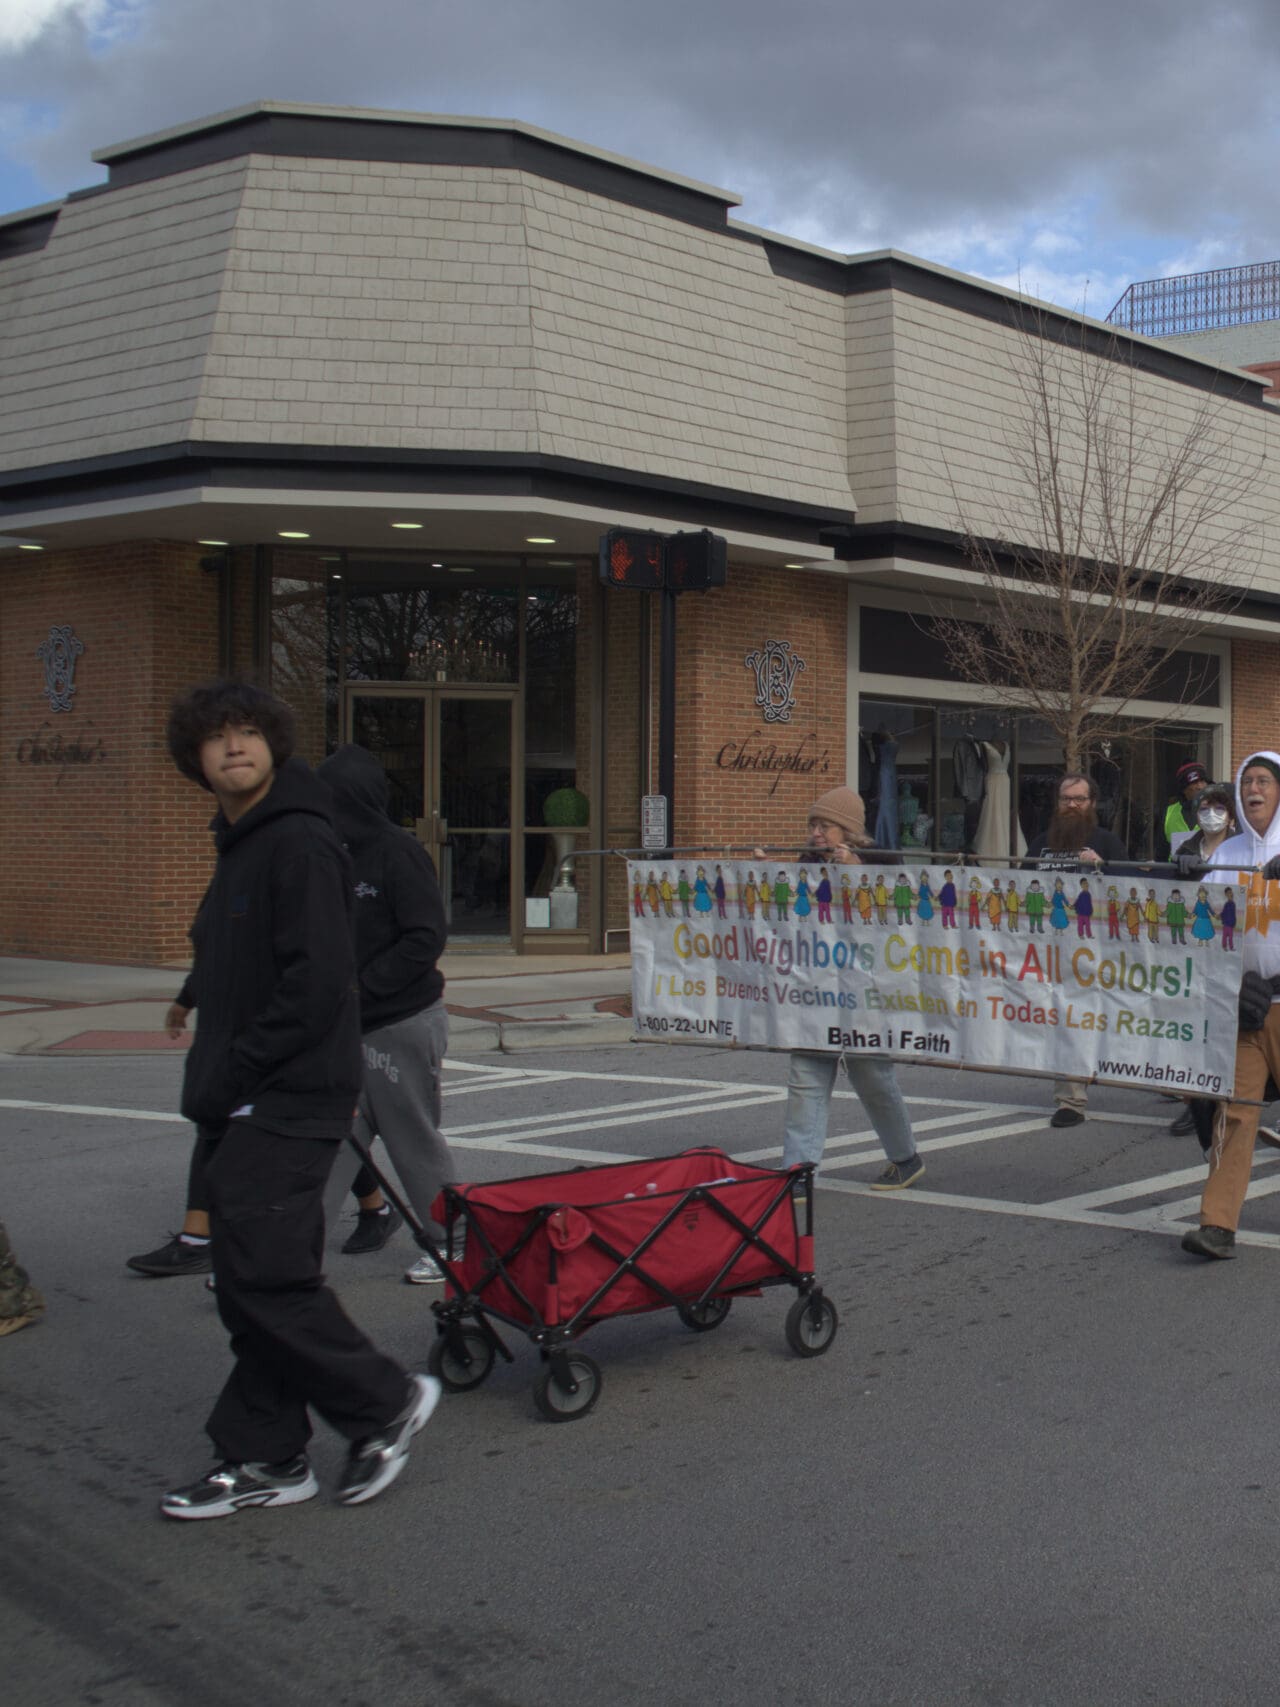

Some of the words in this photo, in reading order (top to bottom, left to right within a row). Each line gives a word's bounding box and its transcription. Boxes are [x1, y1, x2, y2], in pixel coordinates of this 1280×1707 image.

[716, 730, 830, 794] Christopher's
[674, 923, 739, 962] Good
[744, 926, 875, 976] Neighbors
[884, 933, 970, 977] Come
[979, 939, 1008, 980] in
[1018, 943, 1062, 985] All
[1071, 947, 1193, 998] Colors!
[669, 975, 706, 997] Los
[716, 976, 769, 1003] Buenos
[773, 982, 857, 1010] Vecinos
[864, 988, 949, 1016] Existen
[957, 999, 978, 1018] en
[987, 996, 1059, 1026] Todas
[1066, 1004, 1108, 1032] Las
[1116, 1010, 1194, 1042] Razas
[828, 1027, 881, 1049] Baha
[900, 1031, 951, 1054] Faith
[1098, 1060, 1222, 1093] www.bahai.org
